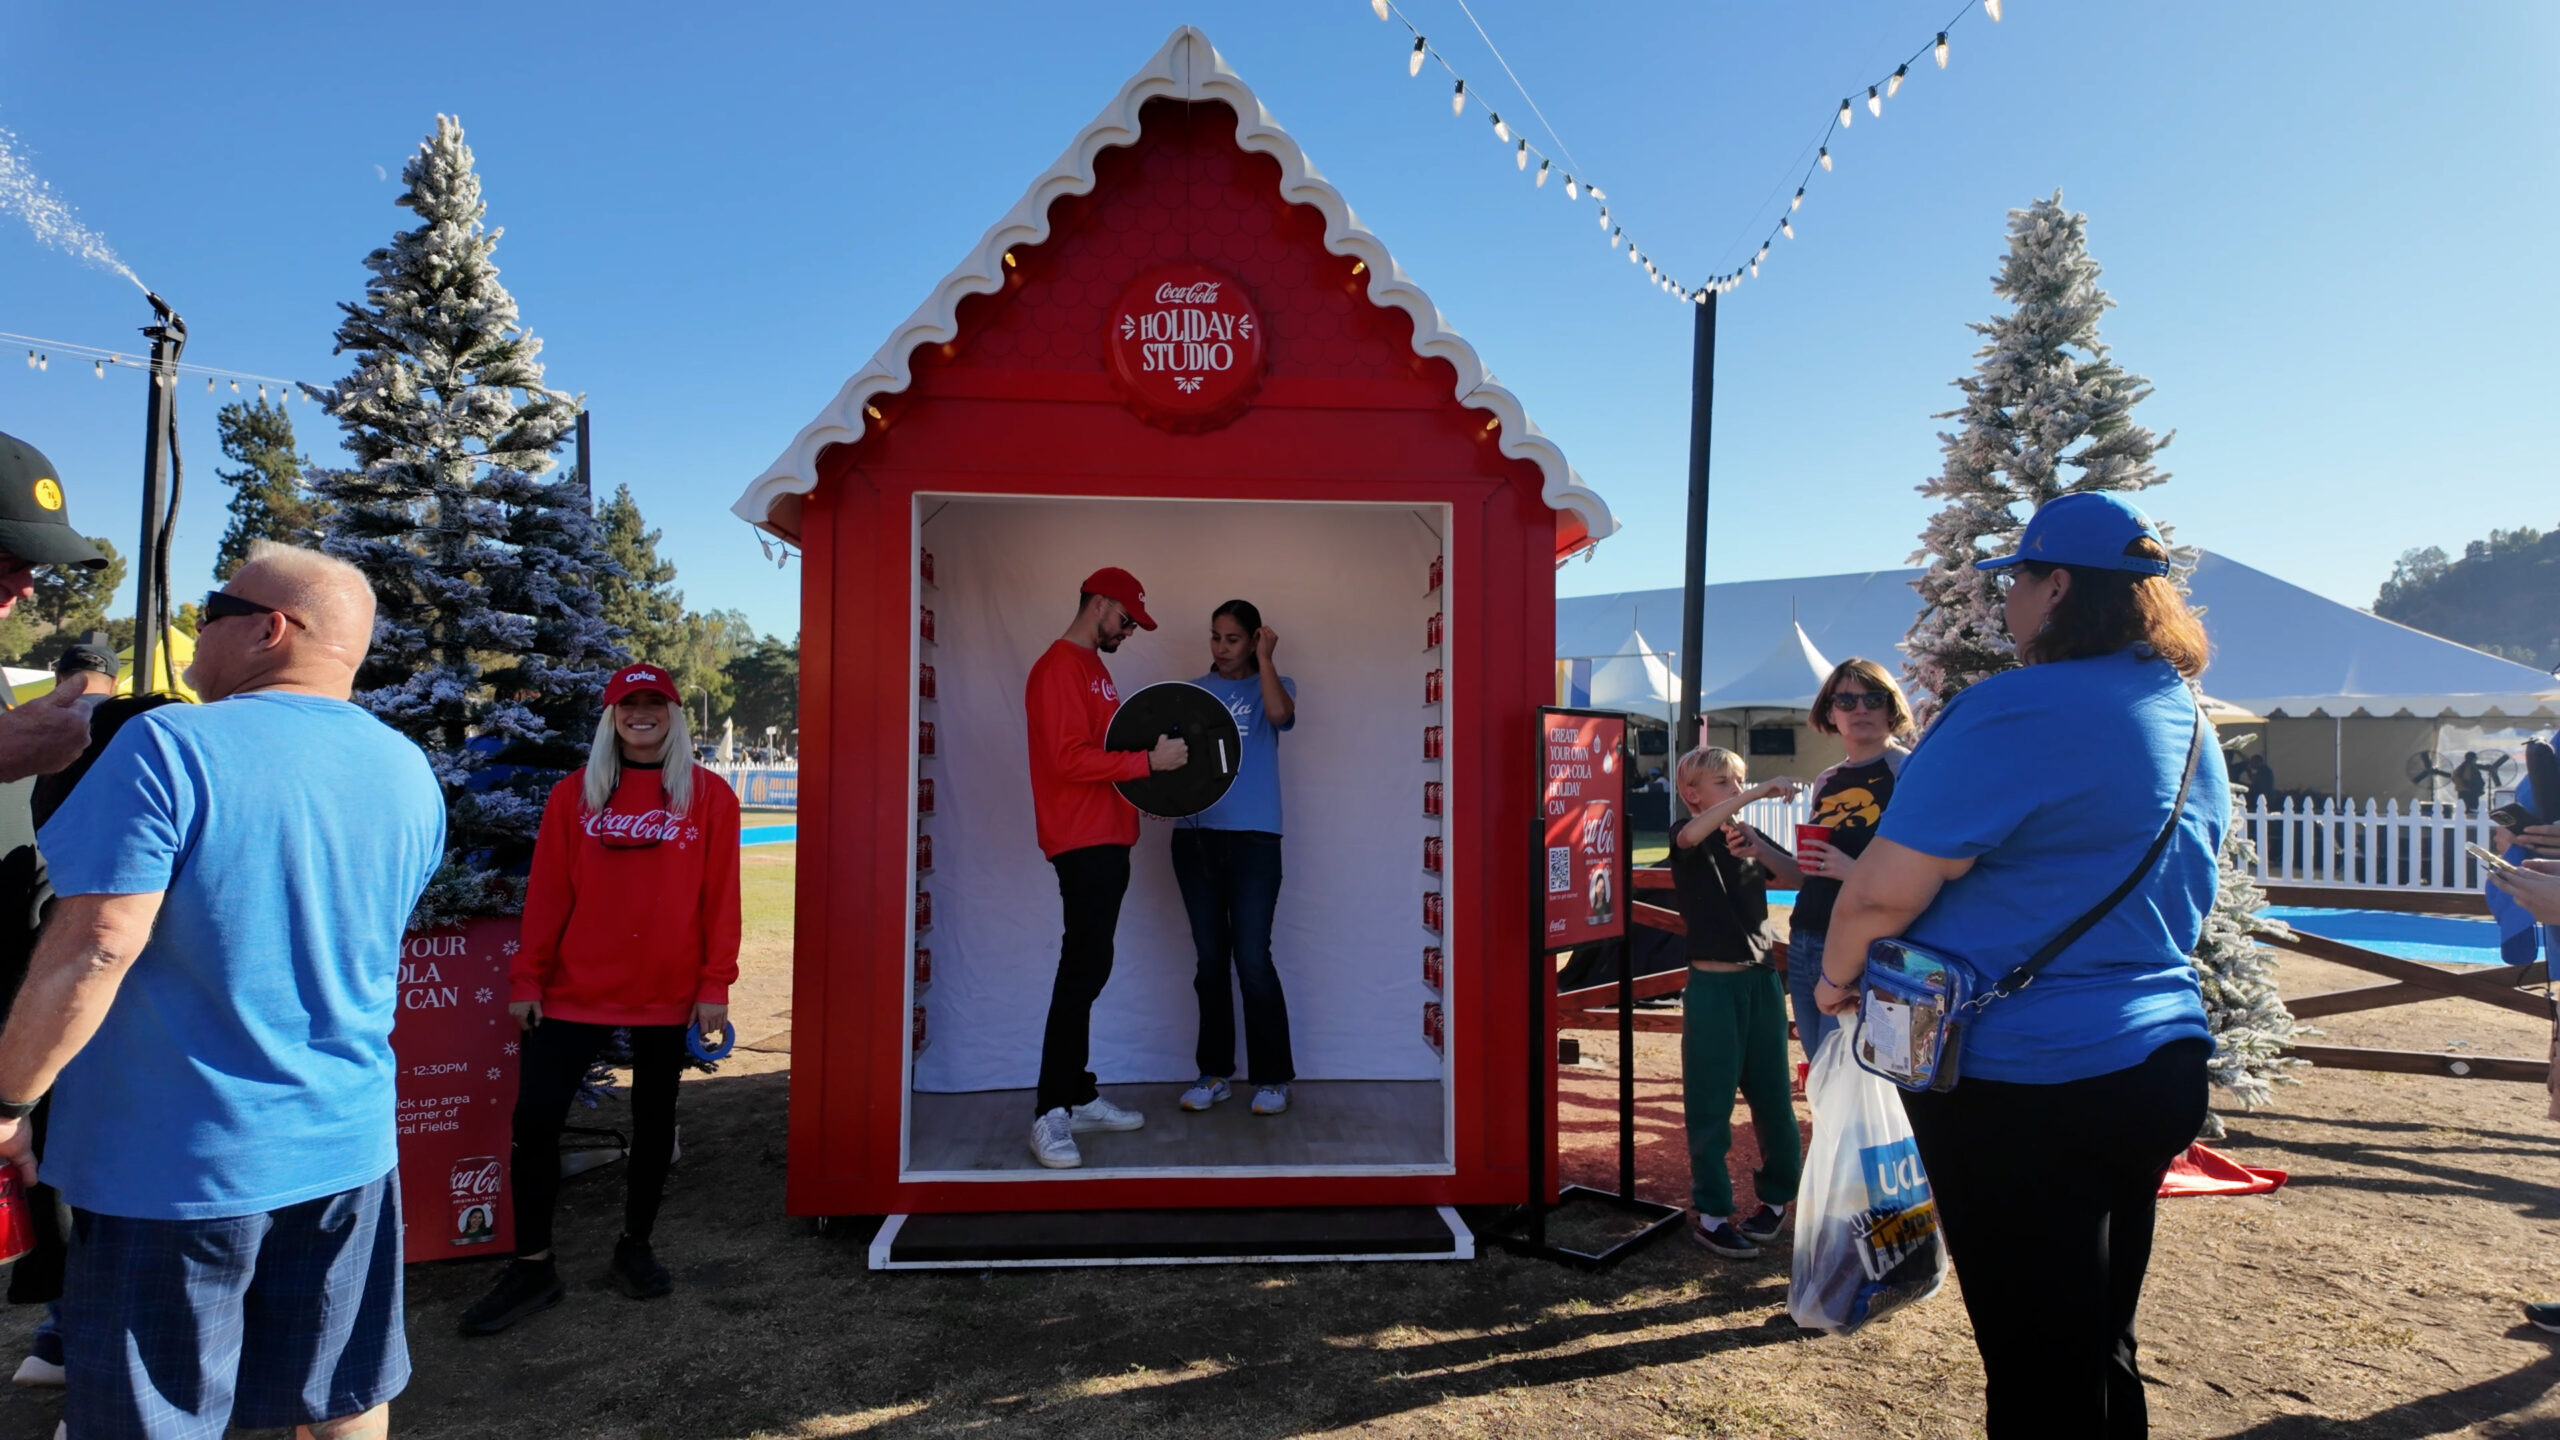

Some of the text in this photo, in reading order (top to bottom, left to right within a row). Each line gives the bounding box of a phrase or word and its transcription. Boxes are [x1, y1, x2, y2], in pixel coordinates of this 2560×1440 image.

[1155, 282, 1221, 304] Coca-Cola
[1140, 309, 1235, 342] HOLIDAY
[1143, 343, 1233, 371] STUDIO
[625, 670, 657, 683] Coke
[1550, 728, 1579, 743] CREATE
[1549, 745, 1589, 761] YOUR OWN
[1549, 781, 1581, 797] HOLIDAY
[1548, 800, 1566, 816] CAN
[584, 808, 687, 841] Coca-Cola
[400, 935, 467, 958] YOUR
[404, 986, 459, 1010] CAN
[413, 1062, 468, 1076] 12:30PM
[397, 1095, 470, 1109] ick up area
[397, 1106, 459, 1122] corner of
[420, 1120, 460, 1133] Fields
